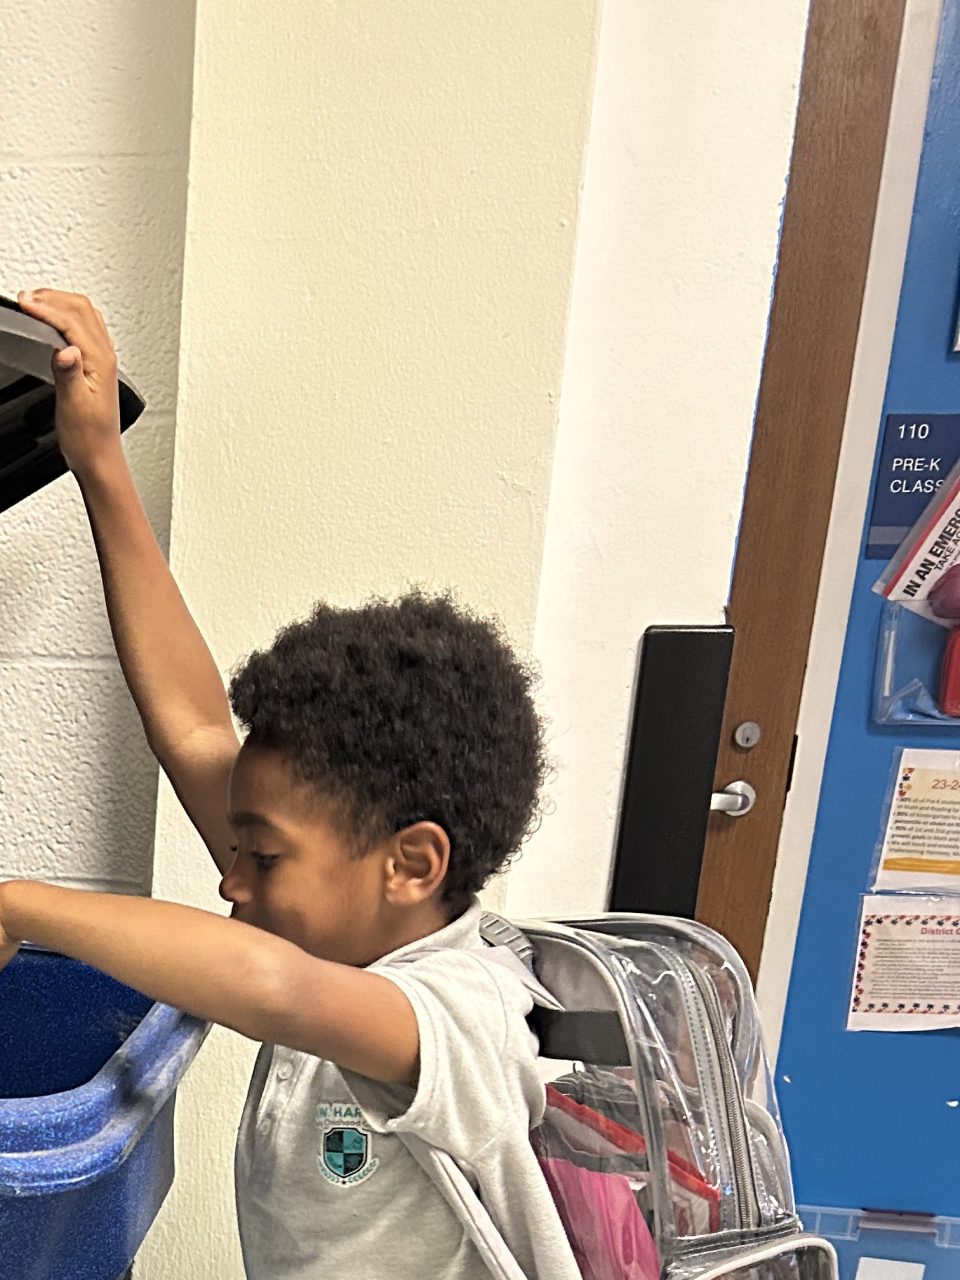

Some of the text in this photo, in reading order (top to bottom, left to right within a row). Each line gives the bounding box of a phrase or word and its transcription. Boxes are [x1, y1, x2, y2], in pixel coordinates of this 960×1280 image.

[898, 423, 929, 439] 110
[892, 457, 941, 471] PRE-K
[934, 545, 955, 571] TAKE
[903, 579, 922, 598] IN
[916, 558, 936, 581] AN
